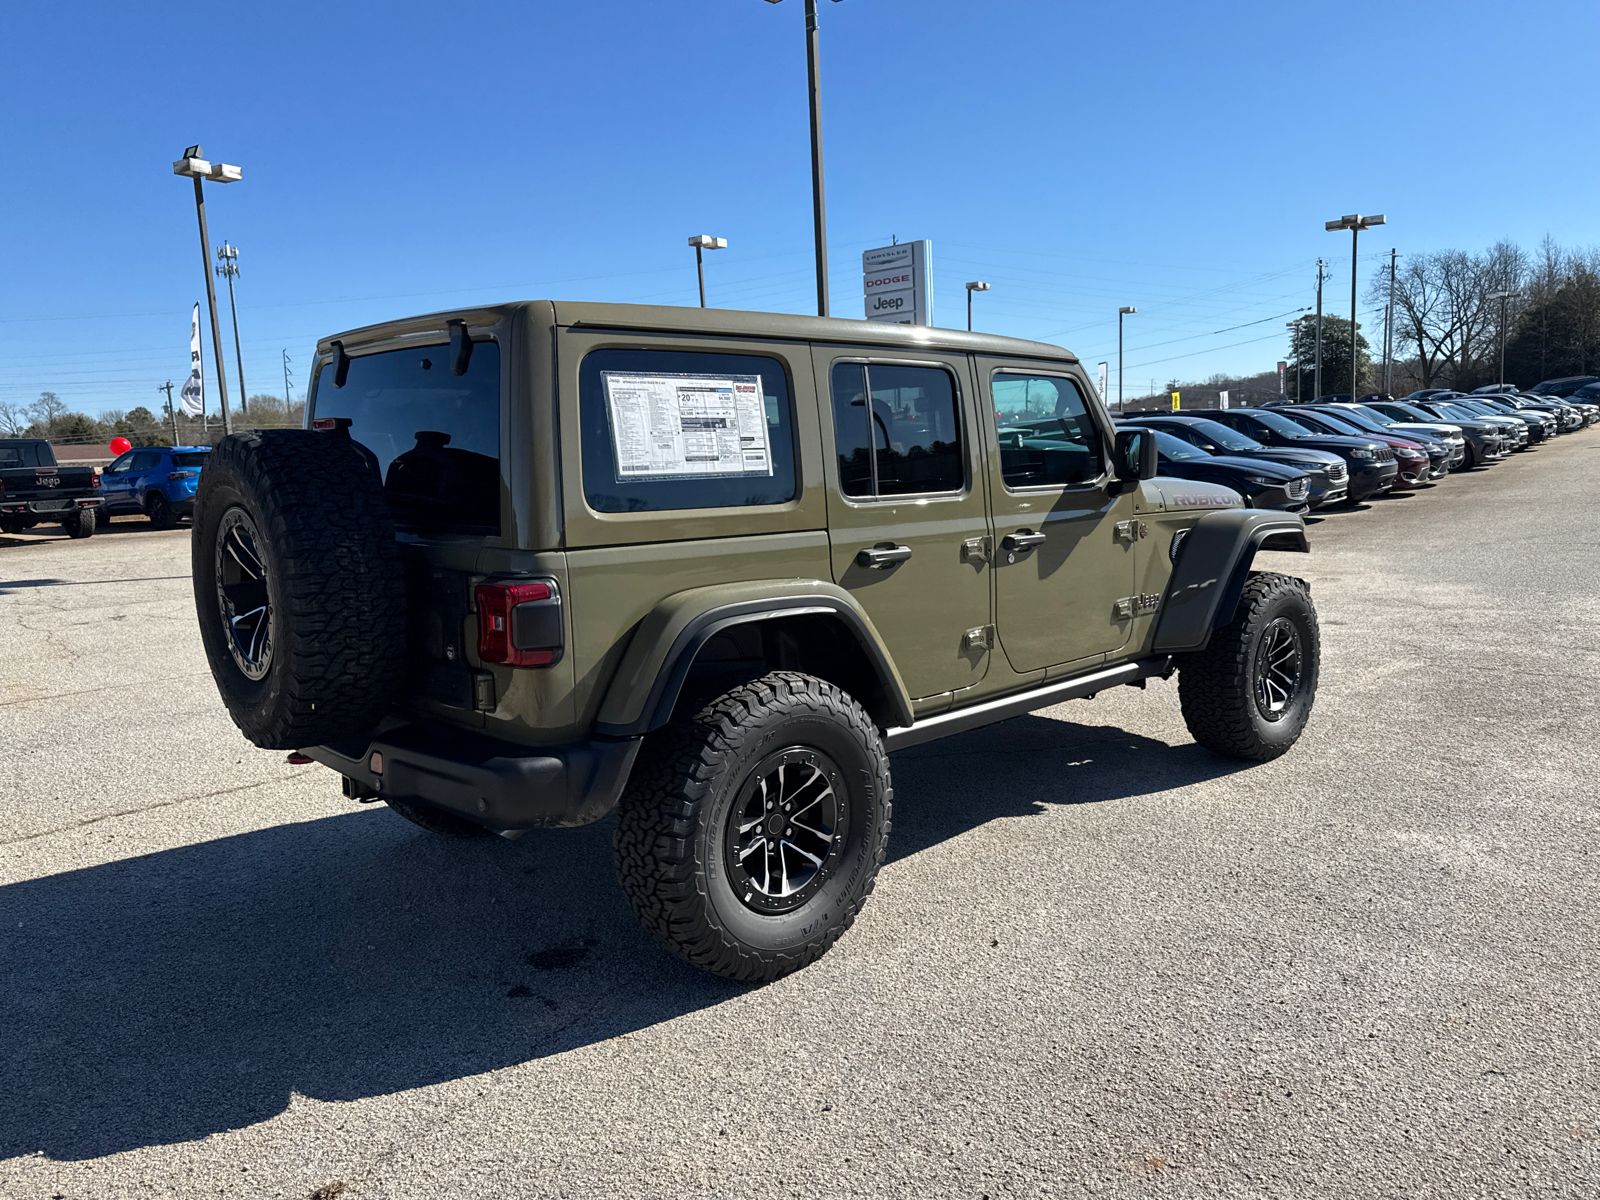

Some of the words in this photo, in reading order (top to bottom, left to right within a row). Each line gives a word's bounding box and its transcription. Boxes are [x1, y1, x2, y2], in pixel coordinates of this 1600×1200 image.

[866, 250, 907, 260] CHRYSLER
[866, 275, 909, 287] DODGE
[873, 297, 904, 310] Jeep
[681, 394, 691, 402] 20
[36, 477, 61, 486] Jeep
[1172, 493, 1243, 506] RUBICON
[1138, 593, 1160, 610] Jeep
